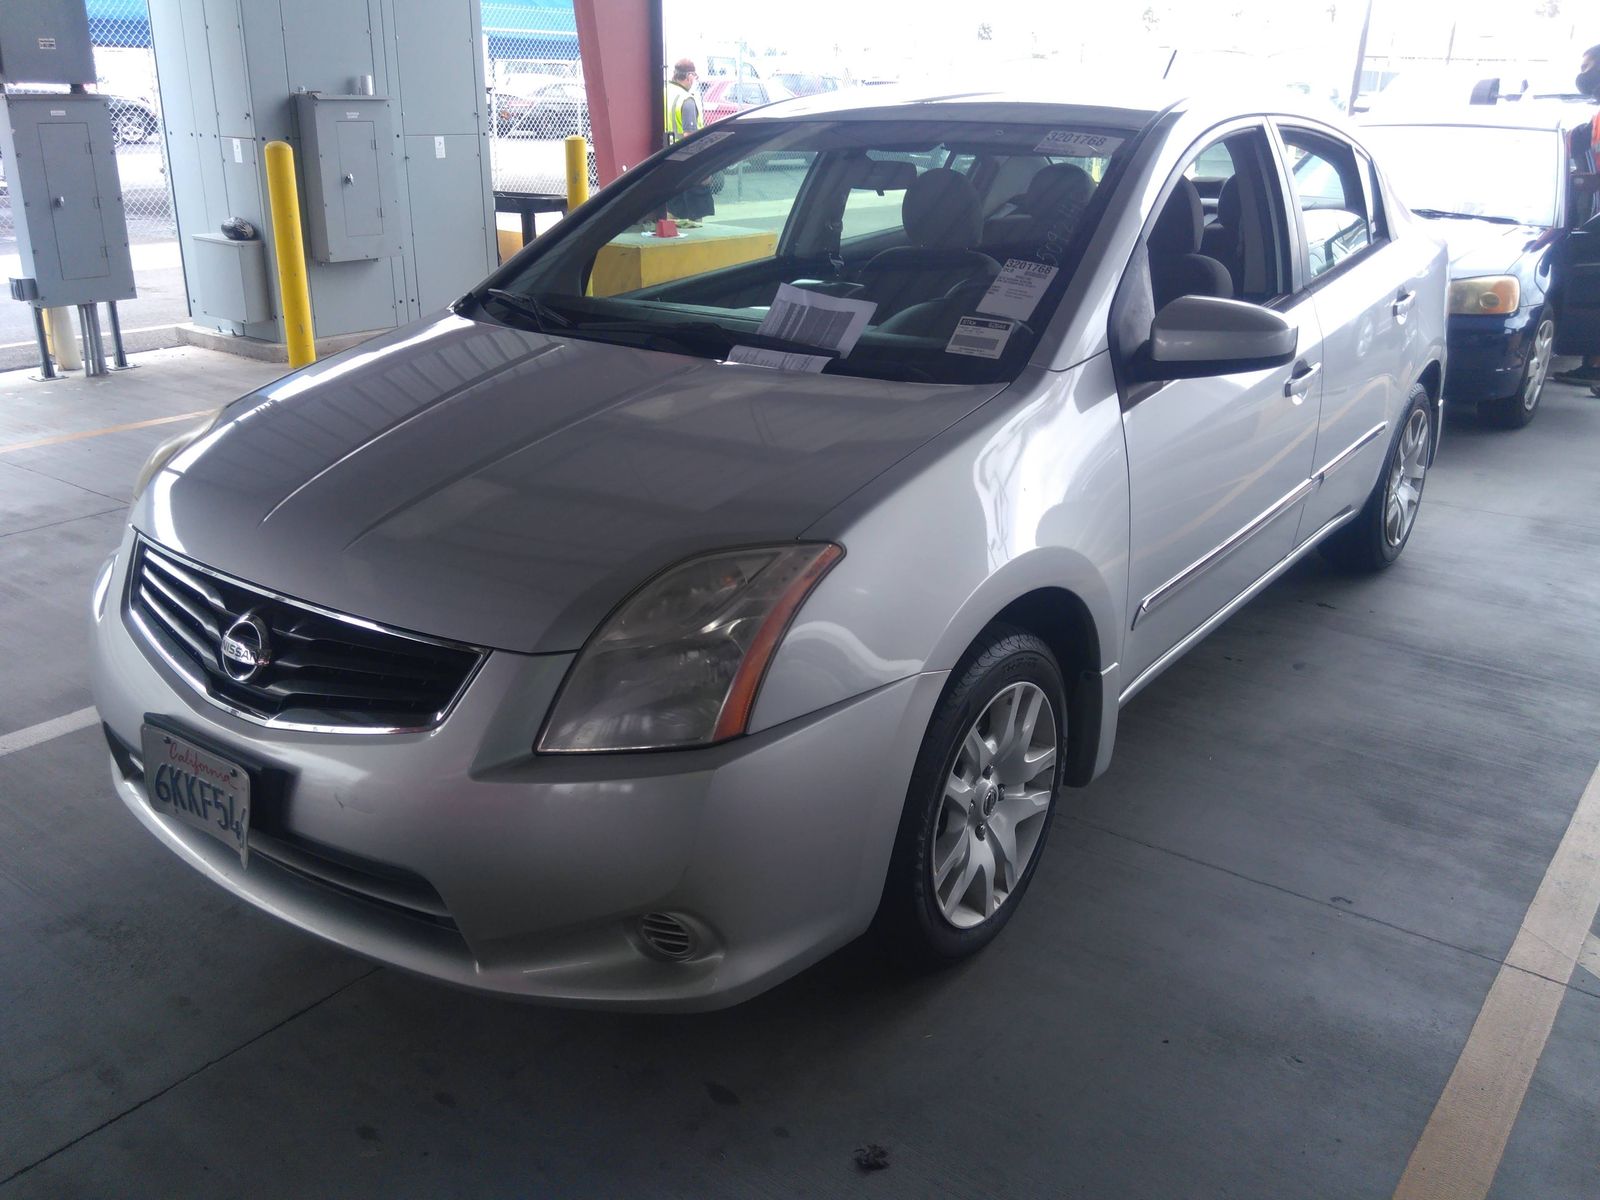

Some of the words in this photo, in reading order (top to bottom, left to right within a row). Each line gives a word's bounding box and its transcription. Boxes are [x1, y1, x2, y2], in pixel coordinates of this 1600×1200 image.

[1046, 131, 1106, 147] 3201768
[1006, 260, 1053, 275] 3201768
[222, 638, 258, 663] NISSAN
[169, 743, 233, 785] California
[155, 763, 248, 850] 6KKF54
